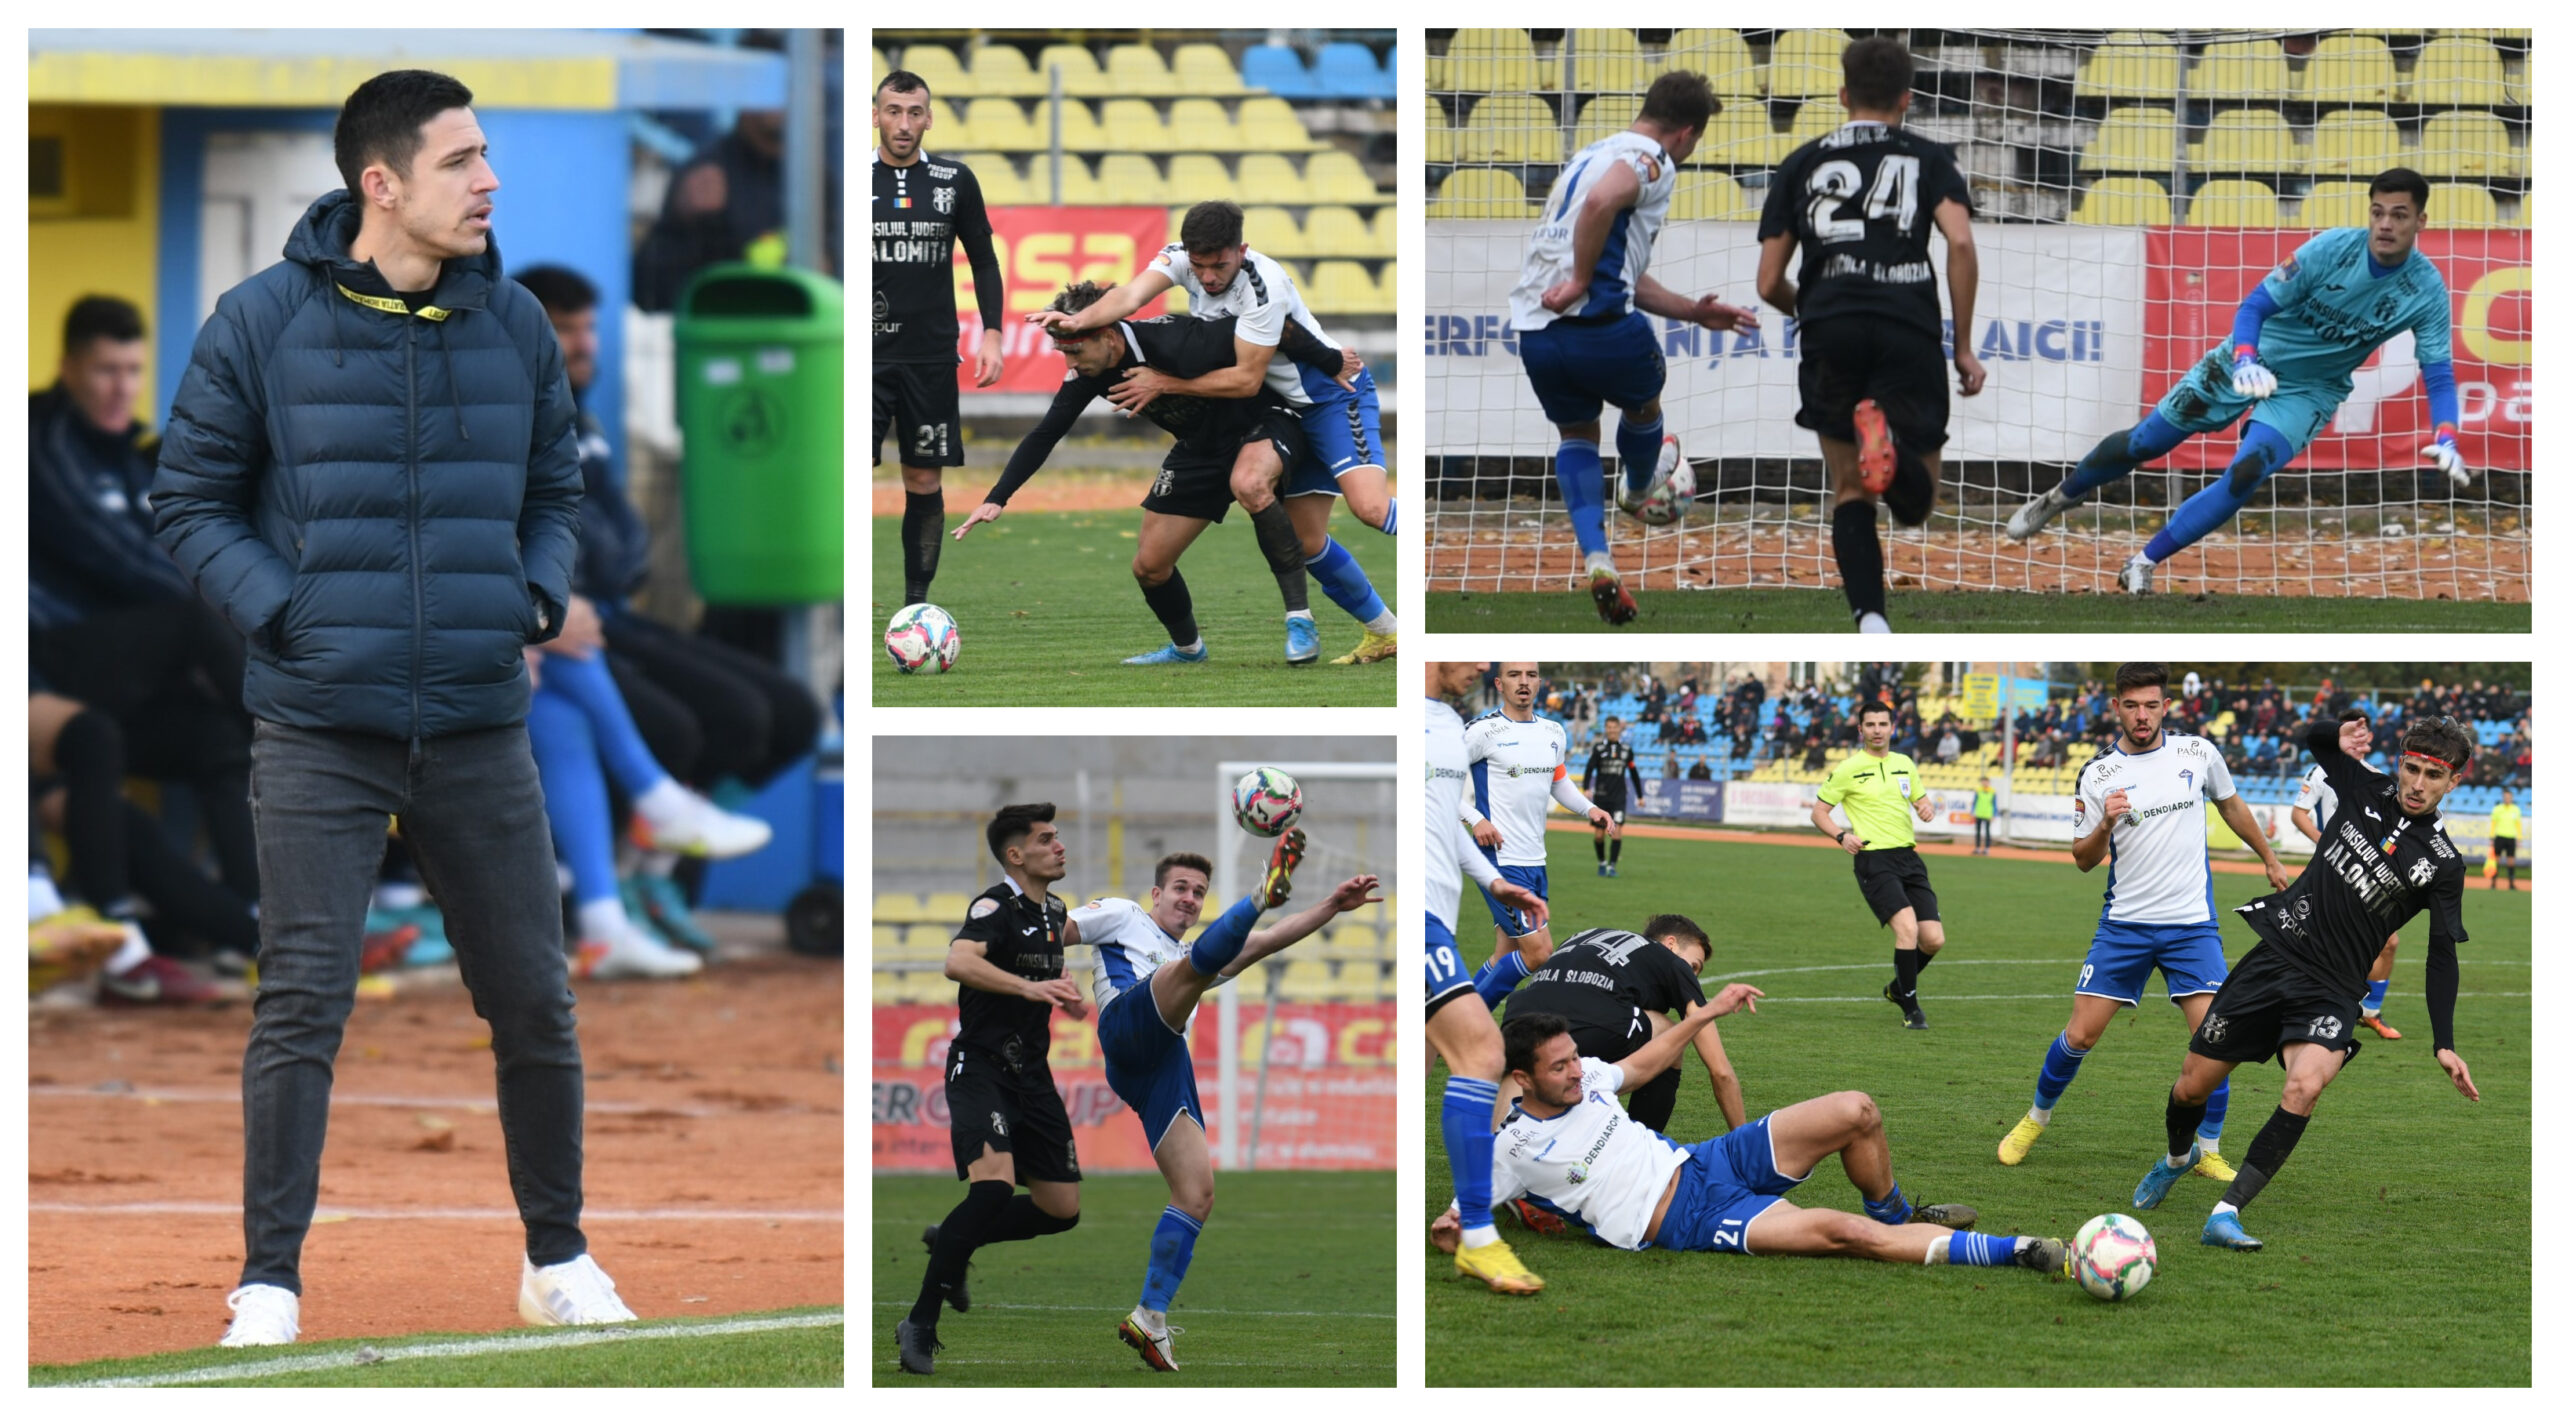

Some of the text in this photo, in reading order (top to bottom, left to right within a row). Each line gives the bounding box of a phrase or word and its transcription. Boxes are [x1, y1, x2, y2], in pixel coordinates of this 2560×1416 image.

[927, 163, 958, 175] PREMIER
[929, 170, 954, 180] GROUP
[1805, 154, 1920, 246] 24
[1872, 261, 1932, 284] SLOBOZIA
[915, 422, 949, 457] 21
[2177, 747, 2207, 760] PASHA
[2143, 800, 2194, 819] DENDIAROM
[2339, 820, 2380, 867] CONSILIUL
[2429, 838, 2448, 858] GROUP
[2432, 833, 2456, 859] PREMIER
[2278, 908, 2308, 939] expur
[1425, 946, 1457, 983] 19
[1564, 969, 1615, 992] SLOBOZIA
[2307, 1015, 2344, 1040] 13
[1509, 1130, 1541, 1158] PASHA
[1584, 1113, 1620, 1165] DENDIAROM
[1712, 1218, 1743, 1246] 21
